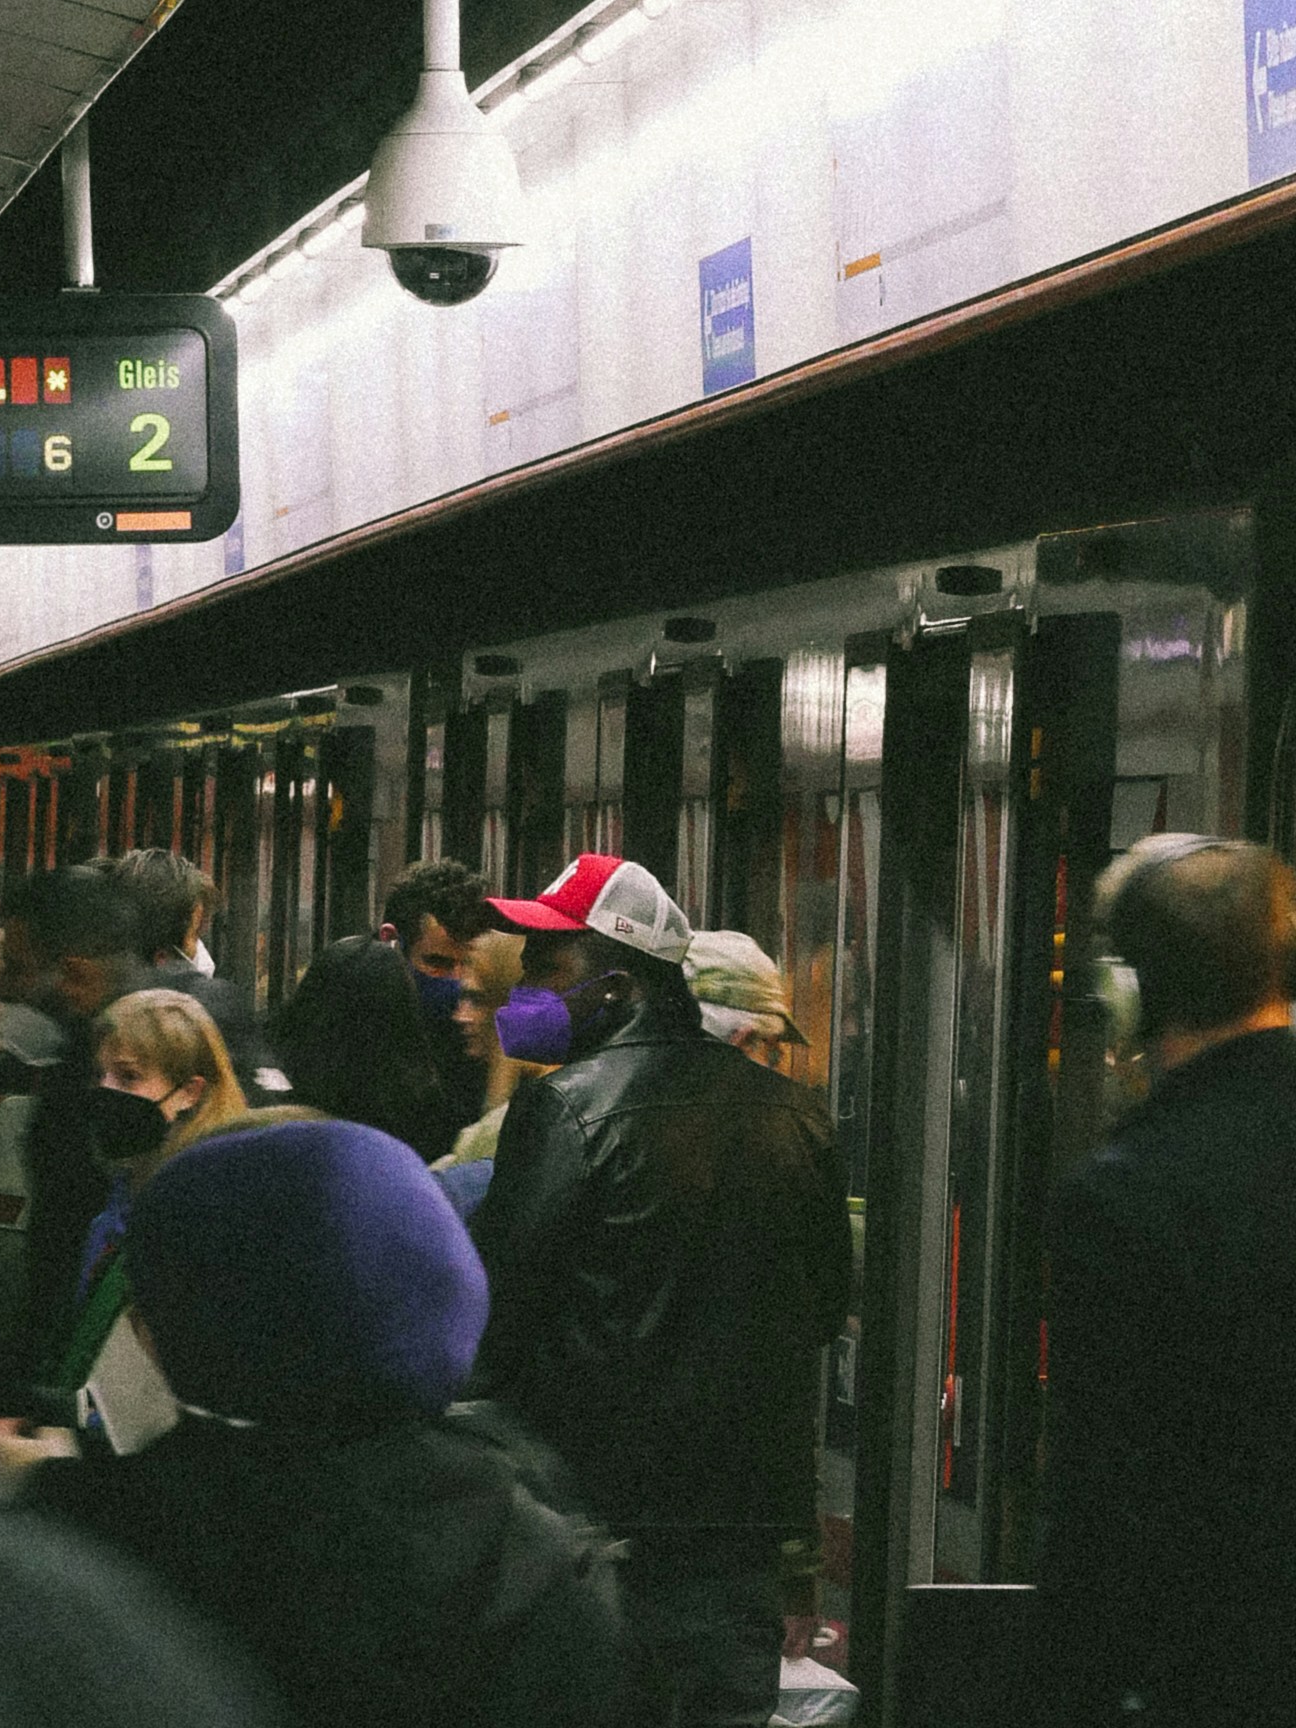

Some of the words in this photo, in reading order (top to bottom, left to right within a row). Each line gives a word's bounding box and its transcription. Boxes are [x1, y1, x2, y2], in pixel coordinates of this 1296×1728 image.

[118, 359, 180, 389] Gleis
[44, 435, 73, 471] 6
[129, 413, 172, 470] 2
